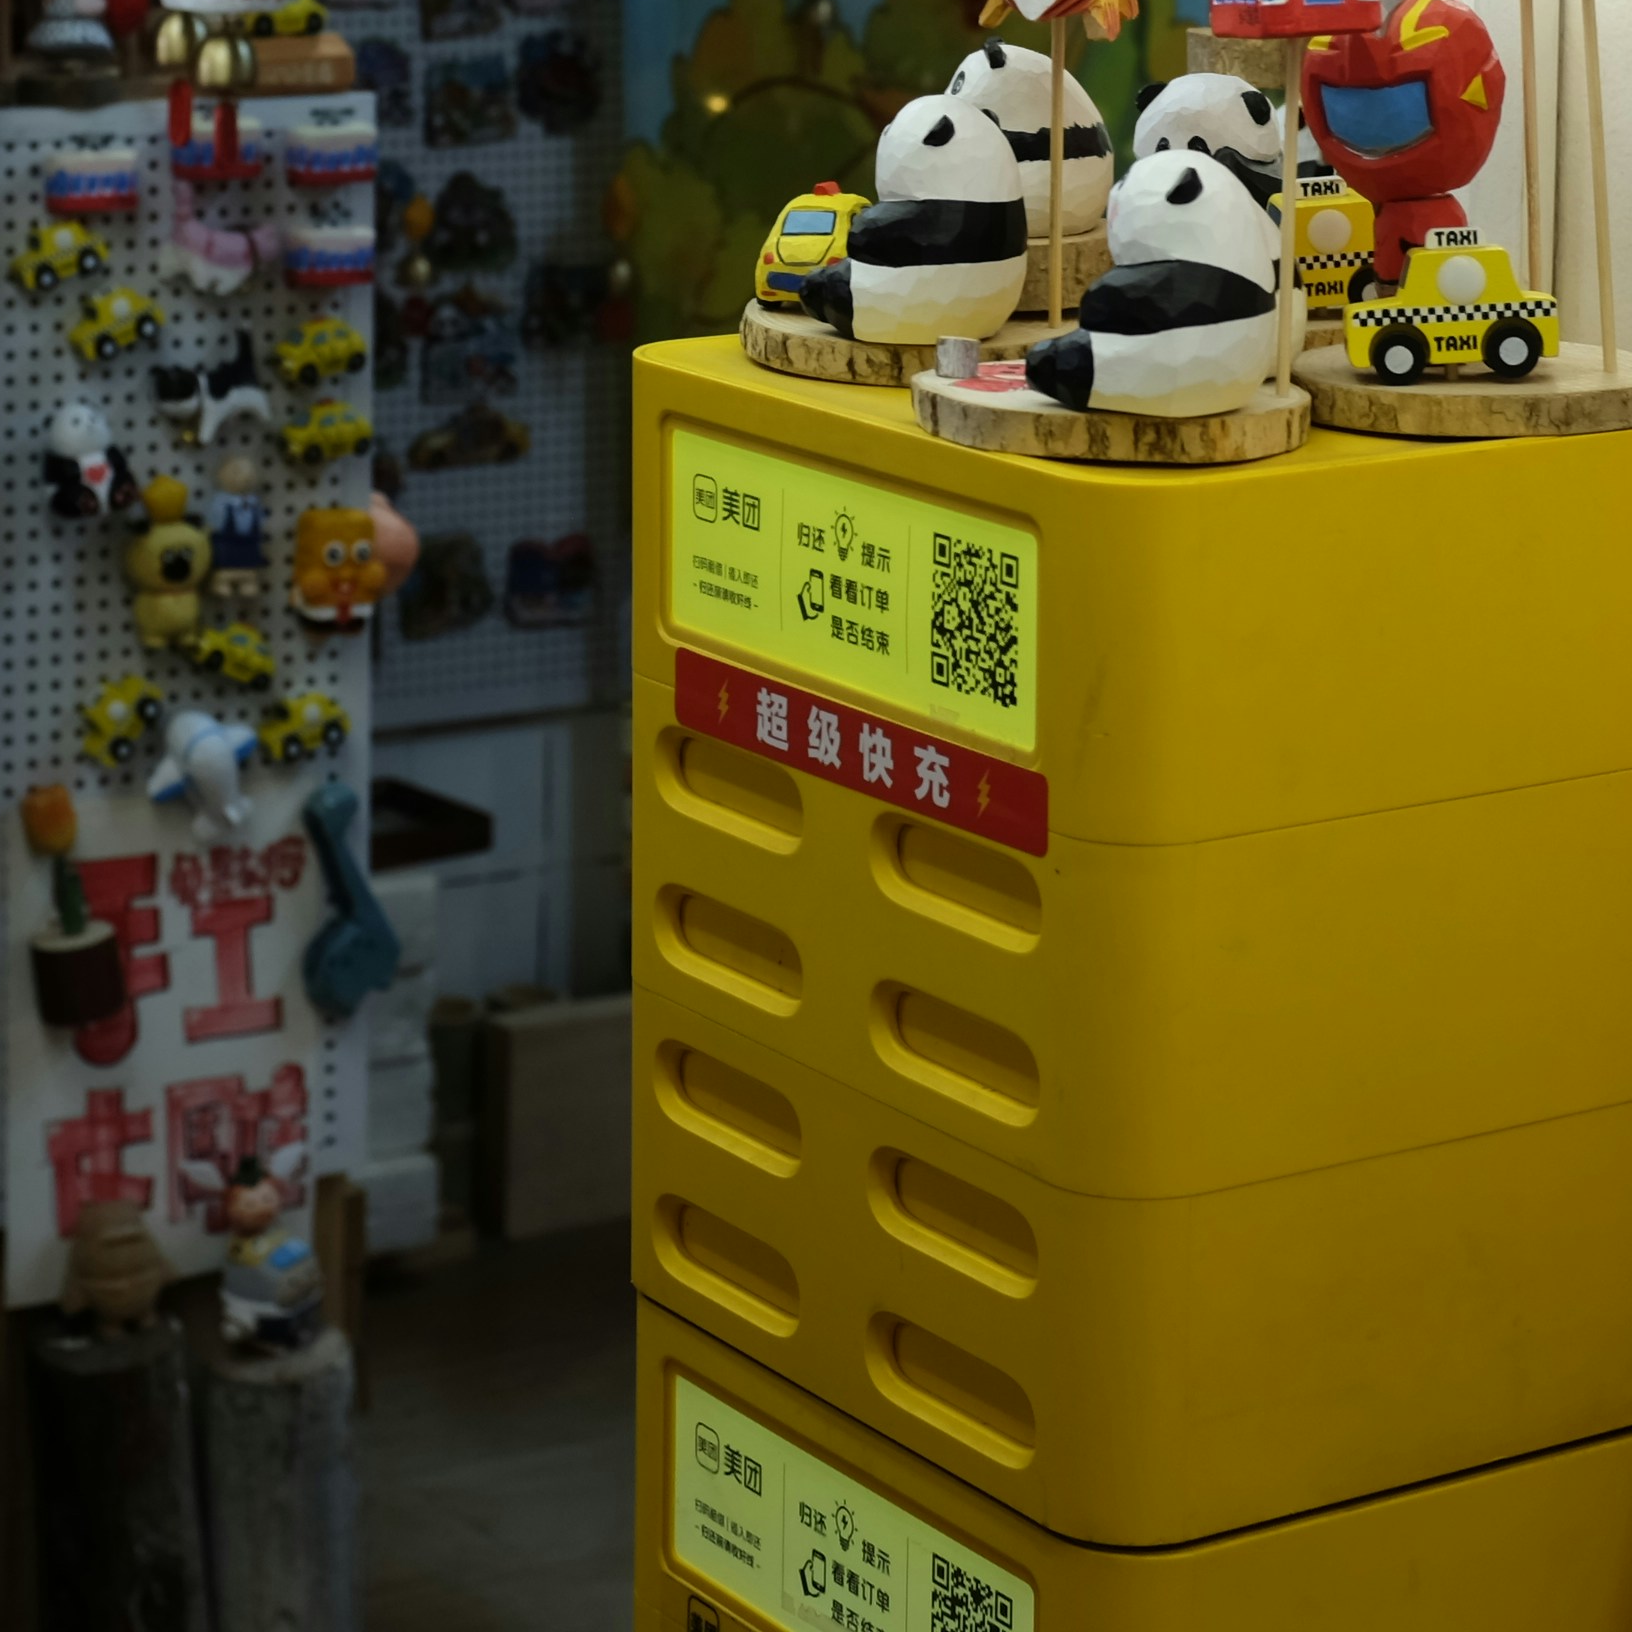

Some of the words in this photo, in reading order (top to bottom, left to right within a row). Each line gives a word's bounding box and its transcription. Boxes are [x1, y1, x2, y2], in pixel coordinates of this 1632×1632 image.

[1300, 181, 1340, 198] TAXI
[1434, 230, 1478, 247] TAXI
[1304, 280, 1345, 298] TAXI
[1433, 335, 1478, 352] TAXI
[695, 488, 716, 510] 美团
[721, 487, 761, 532] 美团
[797, 521, 826, 553] 归还
[860, 541, 891, 574] 提示
[829, 574, 890, 614] 看看订单
[830, 614, 891, 657] 是否结束
[756, 687, 951, 809] 超级快充
[723, 1444, 763, 1498] 美团
[798, 1500, 827, 1537] 归还
[861, 1539, 891, 1577] 提示
[831, 1559, 891, 1614] 看看订单
